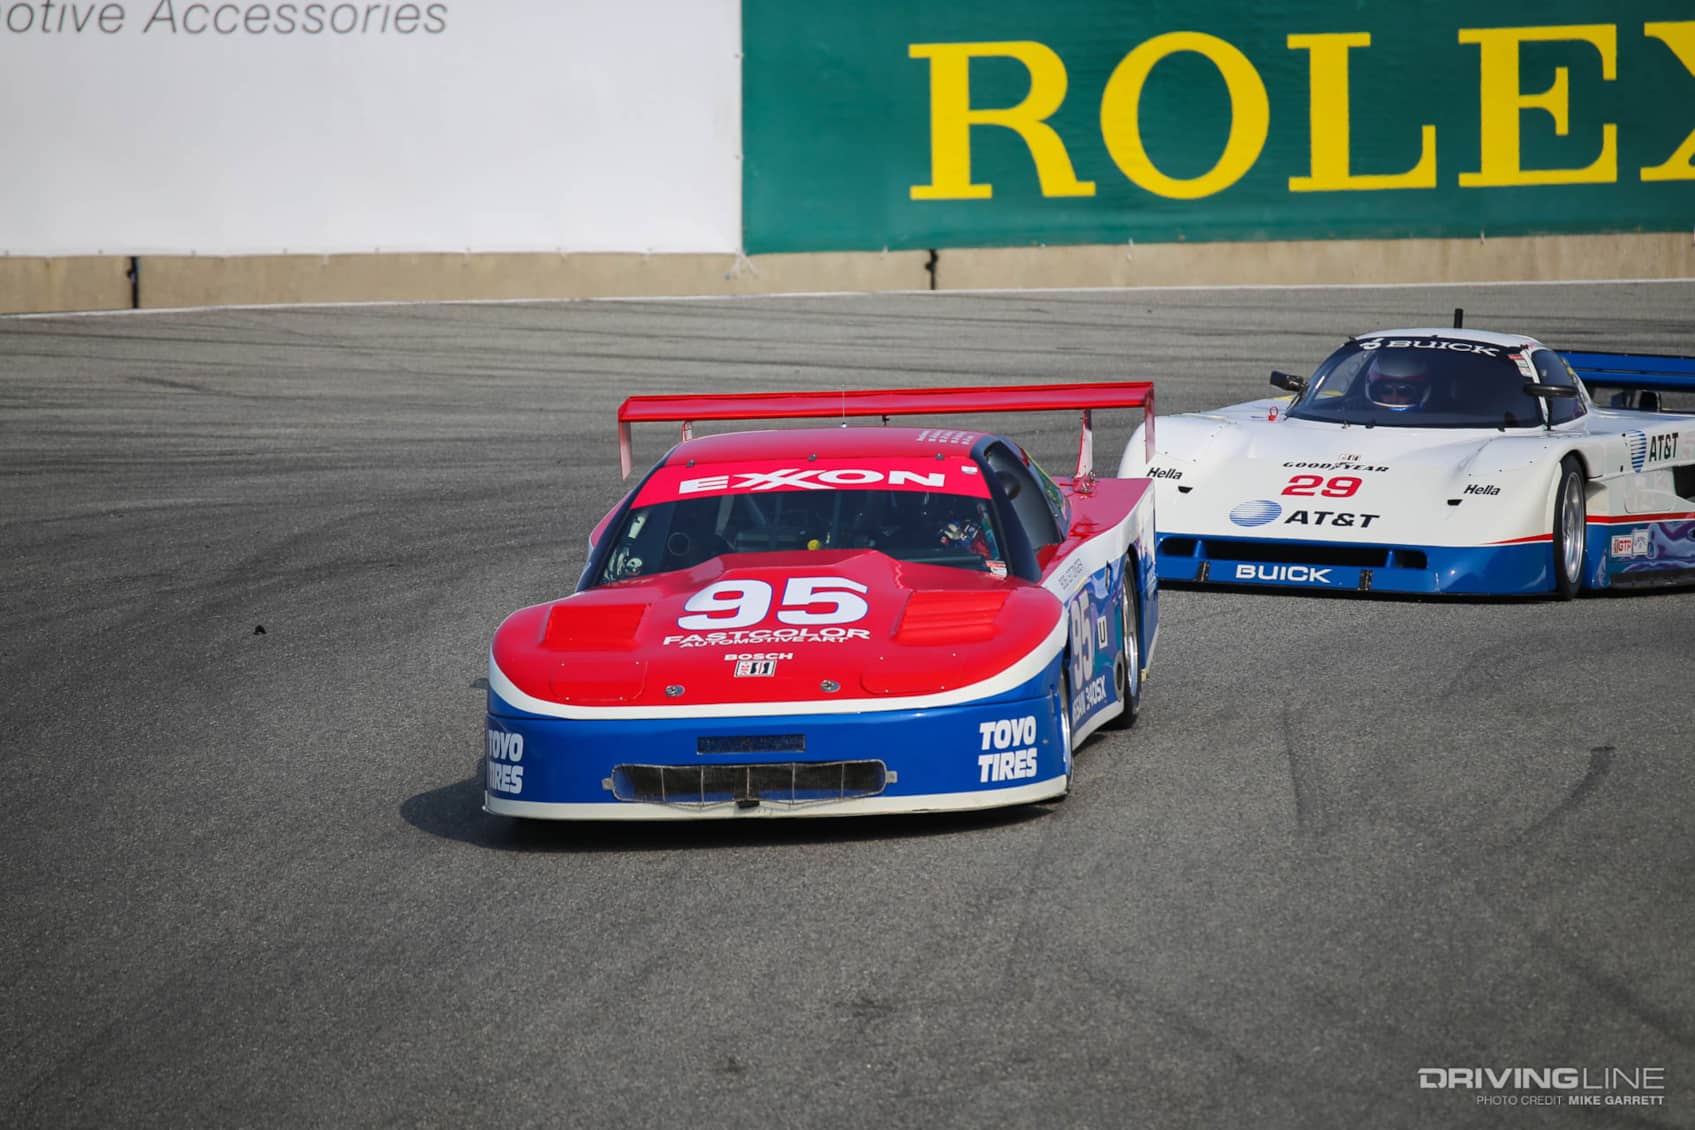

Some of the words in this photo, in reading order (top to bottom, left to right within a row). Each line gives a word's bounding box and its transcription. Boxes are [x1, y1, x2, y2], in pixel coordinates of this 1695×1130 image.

[0, 0, 125, 35] otive
[143, 0, 447, 35] Accessories
[1386, 340, 1500, 357] BUICK
[1648, 432, 1679, 462] AT&T
[1146, 467, 1183, 480] Hella
[1282, 461, 1390, 472] GOODYEAR
[679, 469, 946, 494] EXXON
[1280, 475, 1363, 498] 29
[1463, 484, 1501, 496] Hella
[1283, 510, 1381, 528] AT&T
[1235, 564, 1333, 583] BUICK
[677, 576, 869, 630] 95
[663, 628, 871, 646] FASTCOLOR
[680, 636, 804, 648] AUTOMOTIVE
[808, 635, 849, 644] ART
[1071, 590, 1093, 690] 95
[724, 653, 793, 661] BOSCH
[980, 716, 1036, 750] TOYO
[488, 729, 523, 761] TOYO
[978, 747, 1037, 783] TIRES
[488, 761, 524, 794] TIRES
